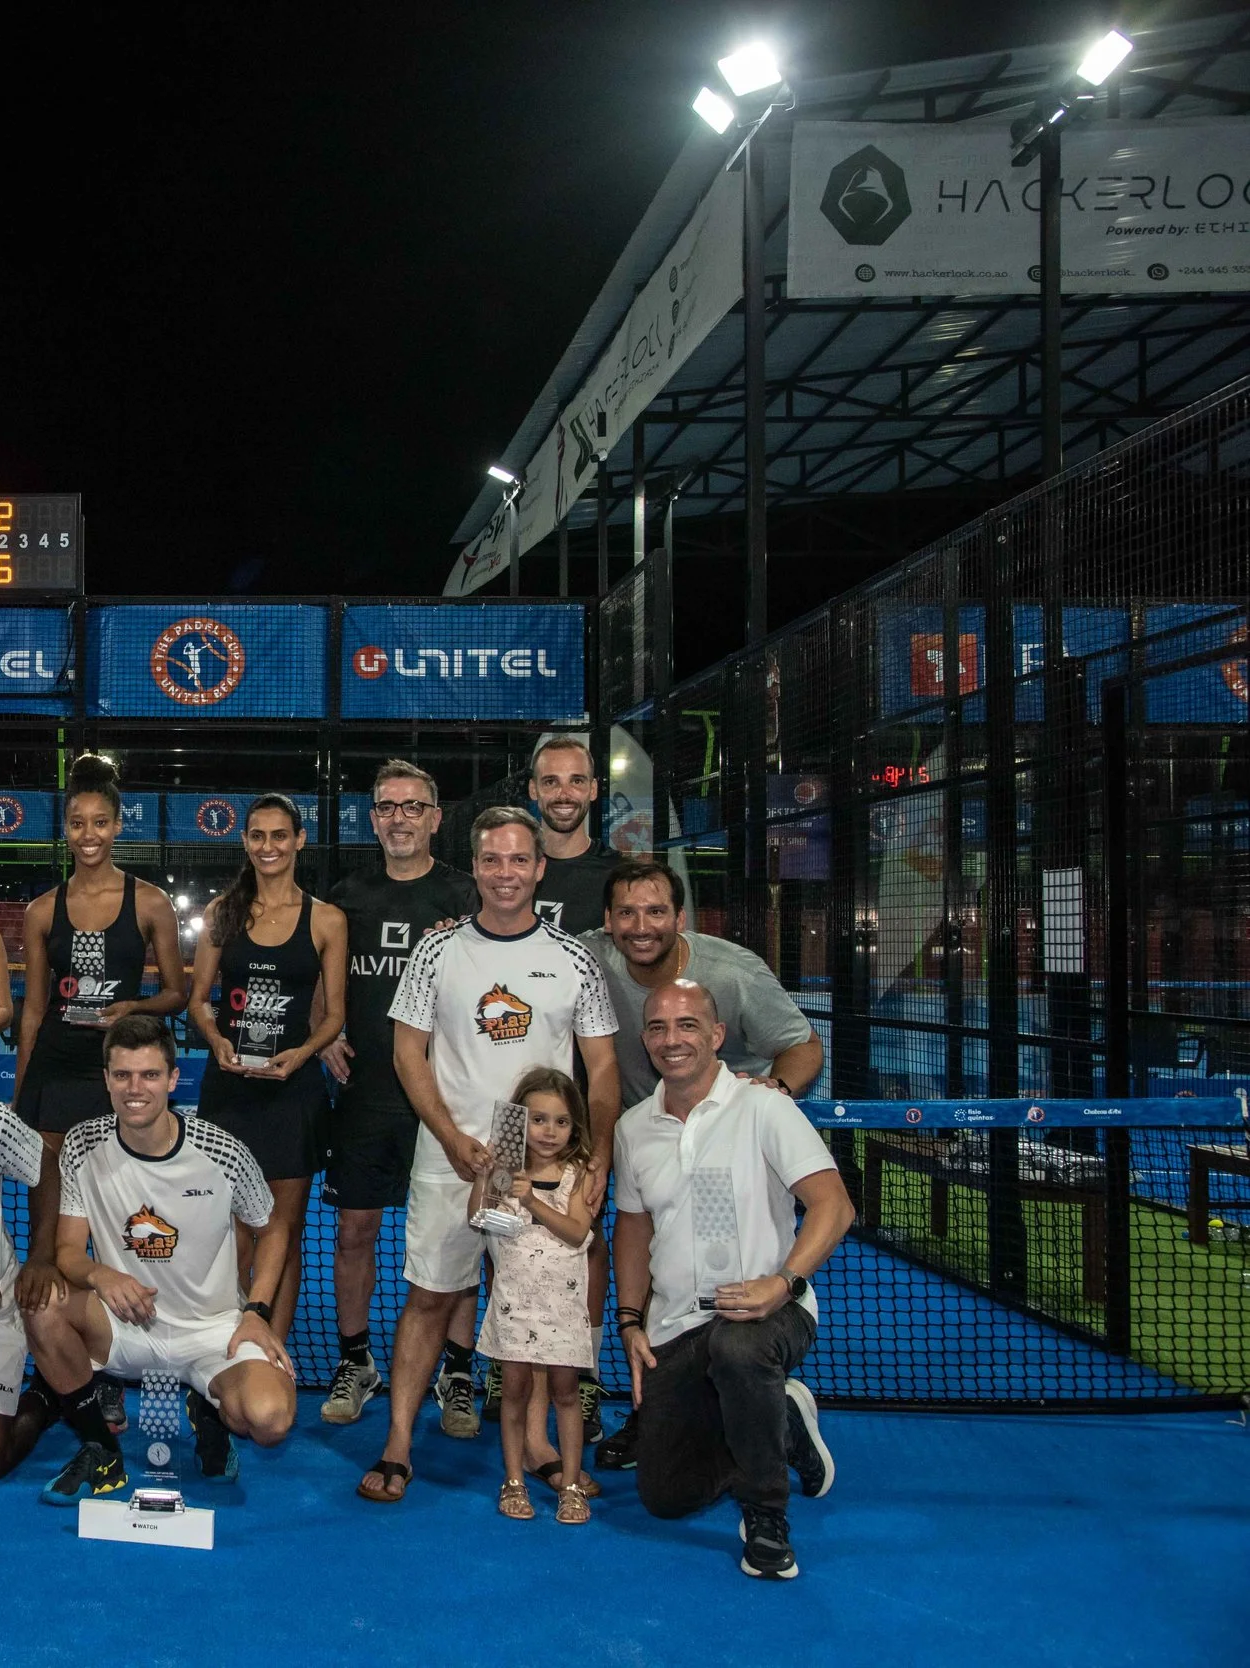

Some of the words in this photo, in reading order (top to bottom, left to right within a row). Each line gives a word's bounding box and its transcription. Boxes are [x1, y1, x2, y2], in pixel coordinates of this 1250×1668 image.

[937, 173, 1250, 213] HACKERLO
[1106, 225, 1165, 236] Powered
[1168, 223, 1190, 237] by:
[155, 634, 173, 659] THE
[174, 621, 219, 635] PADEL
[223, 633, 240, 660] CUP
[395, 649, 556, 677] UNITEL
[161, 677, 209, 703] UNITEL
[213, 676, 236, 698] BFA
[137, 1523, 158, 1531] WATCH
